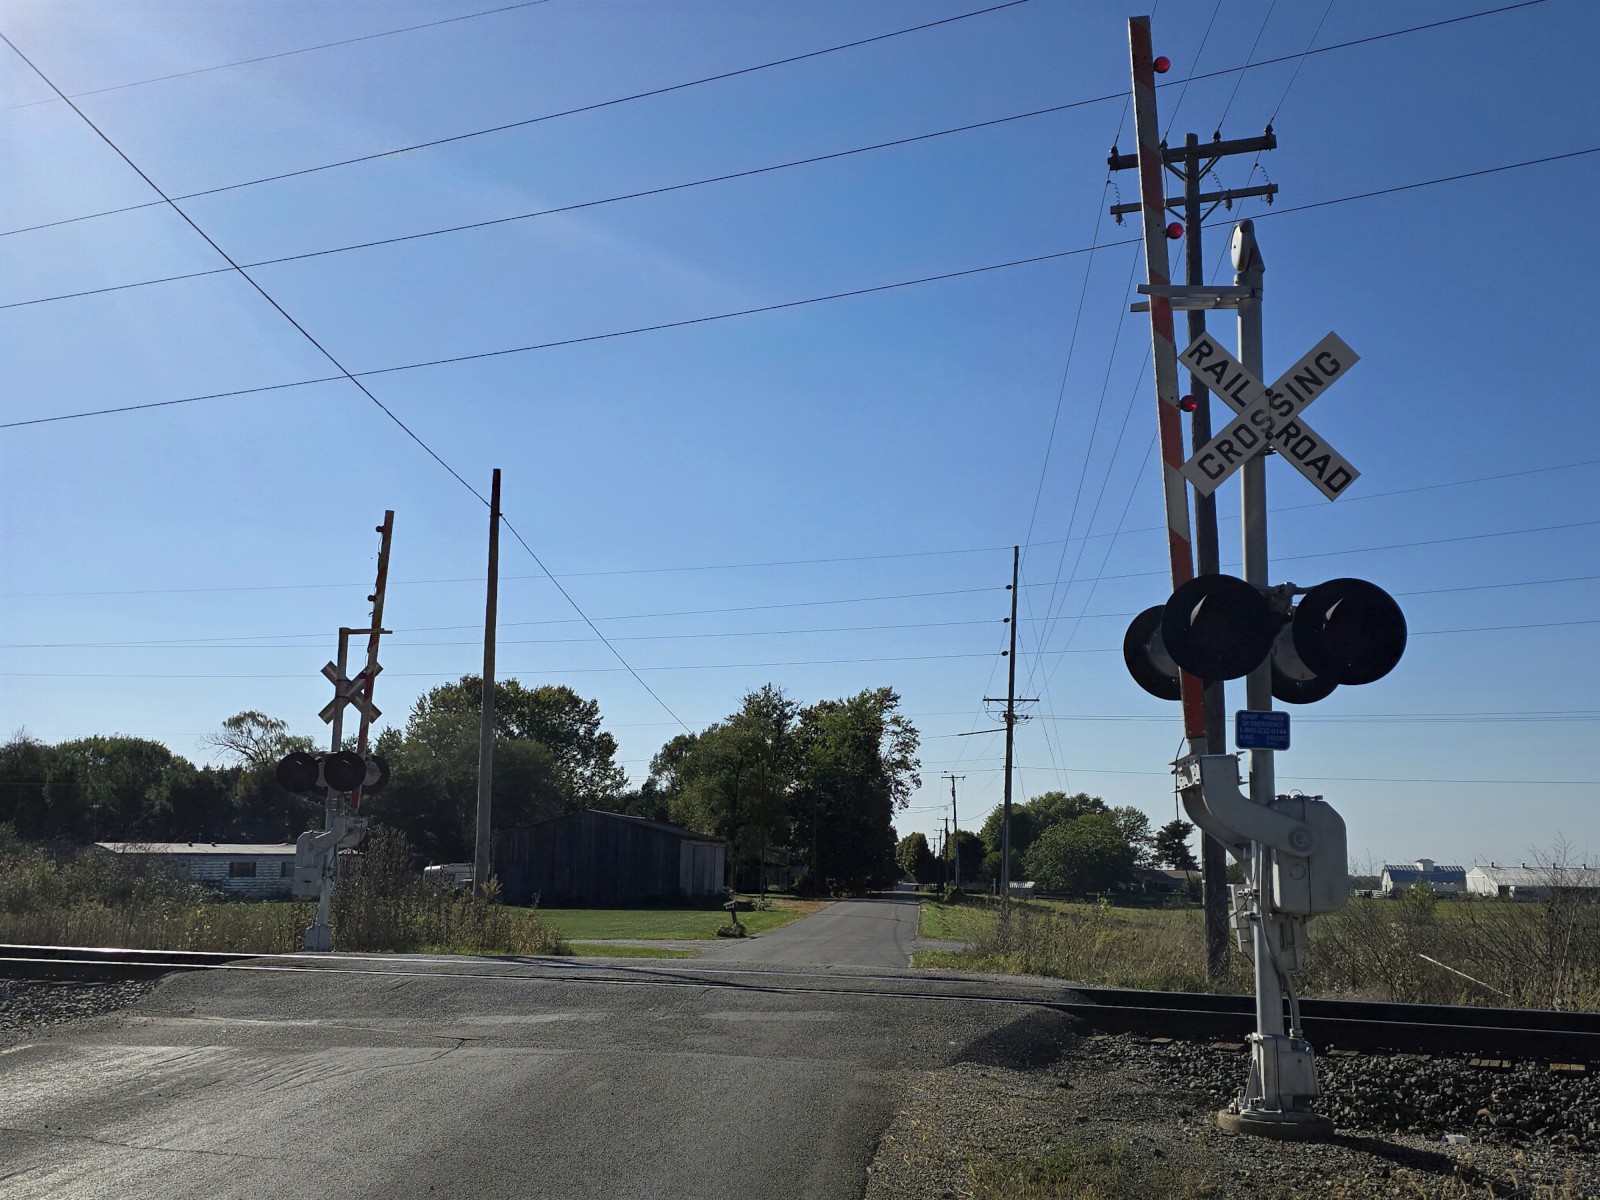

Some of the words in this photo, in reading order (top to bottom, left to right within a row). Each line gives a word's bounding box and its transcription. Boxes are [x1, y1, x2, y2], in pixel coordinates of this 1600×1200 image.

[1188, 339, 1251, 408] RAIL
[1274, 420, 1353, 493] ROAD
[1197, 351, 1341, 480] CROSSING
